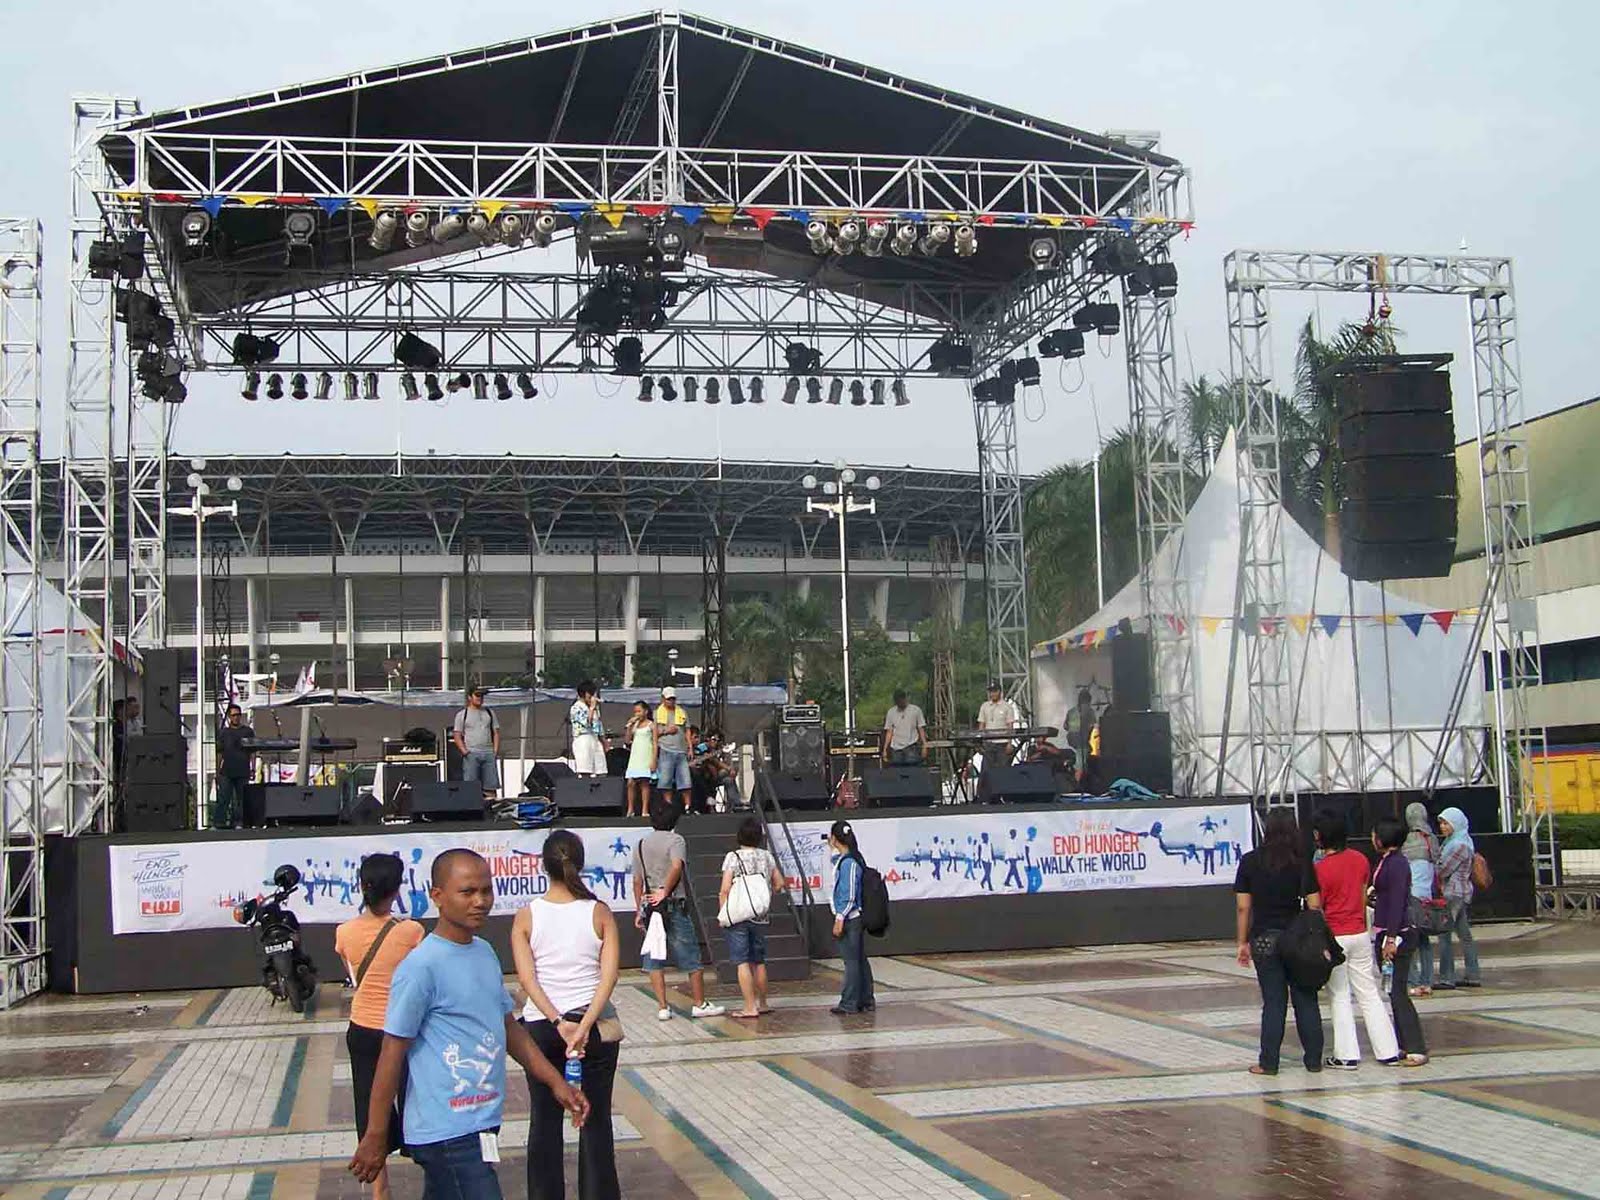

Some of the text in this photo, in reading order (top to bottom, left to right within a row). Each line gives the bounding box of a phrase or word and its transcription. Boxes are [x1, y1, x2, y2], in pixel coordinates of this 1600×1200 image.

[1053, 832, 1139, 856] END HUNGER
[133, 864, 188, 884] HUNGER
[486, 855, 540, 876] UNGER
[1040, 853, 1147, 875] WALK THE WORLD
[495, 876, 547, 896] WORLD
